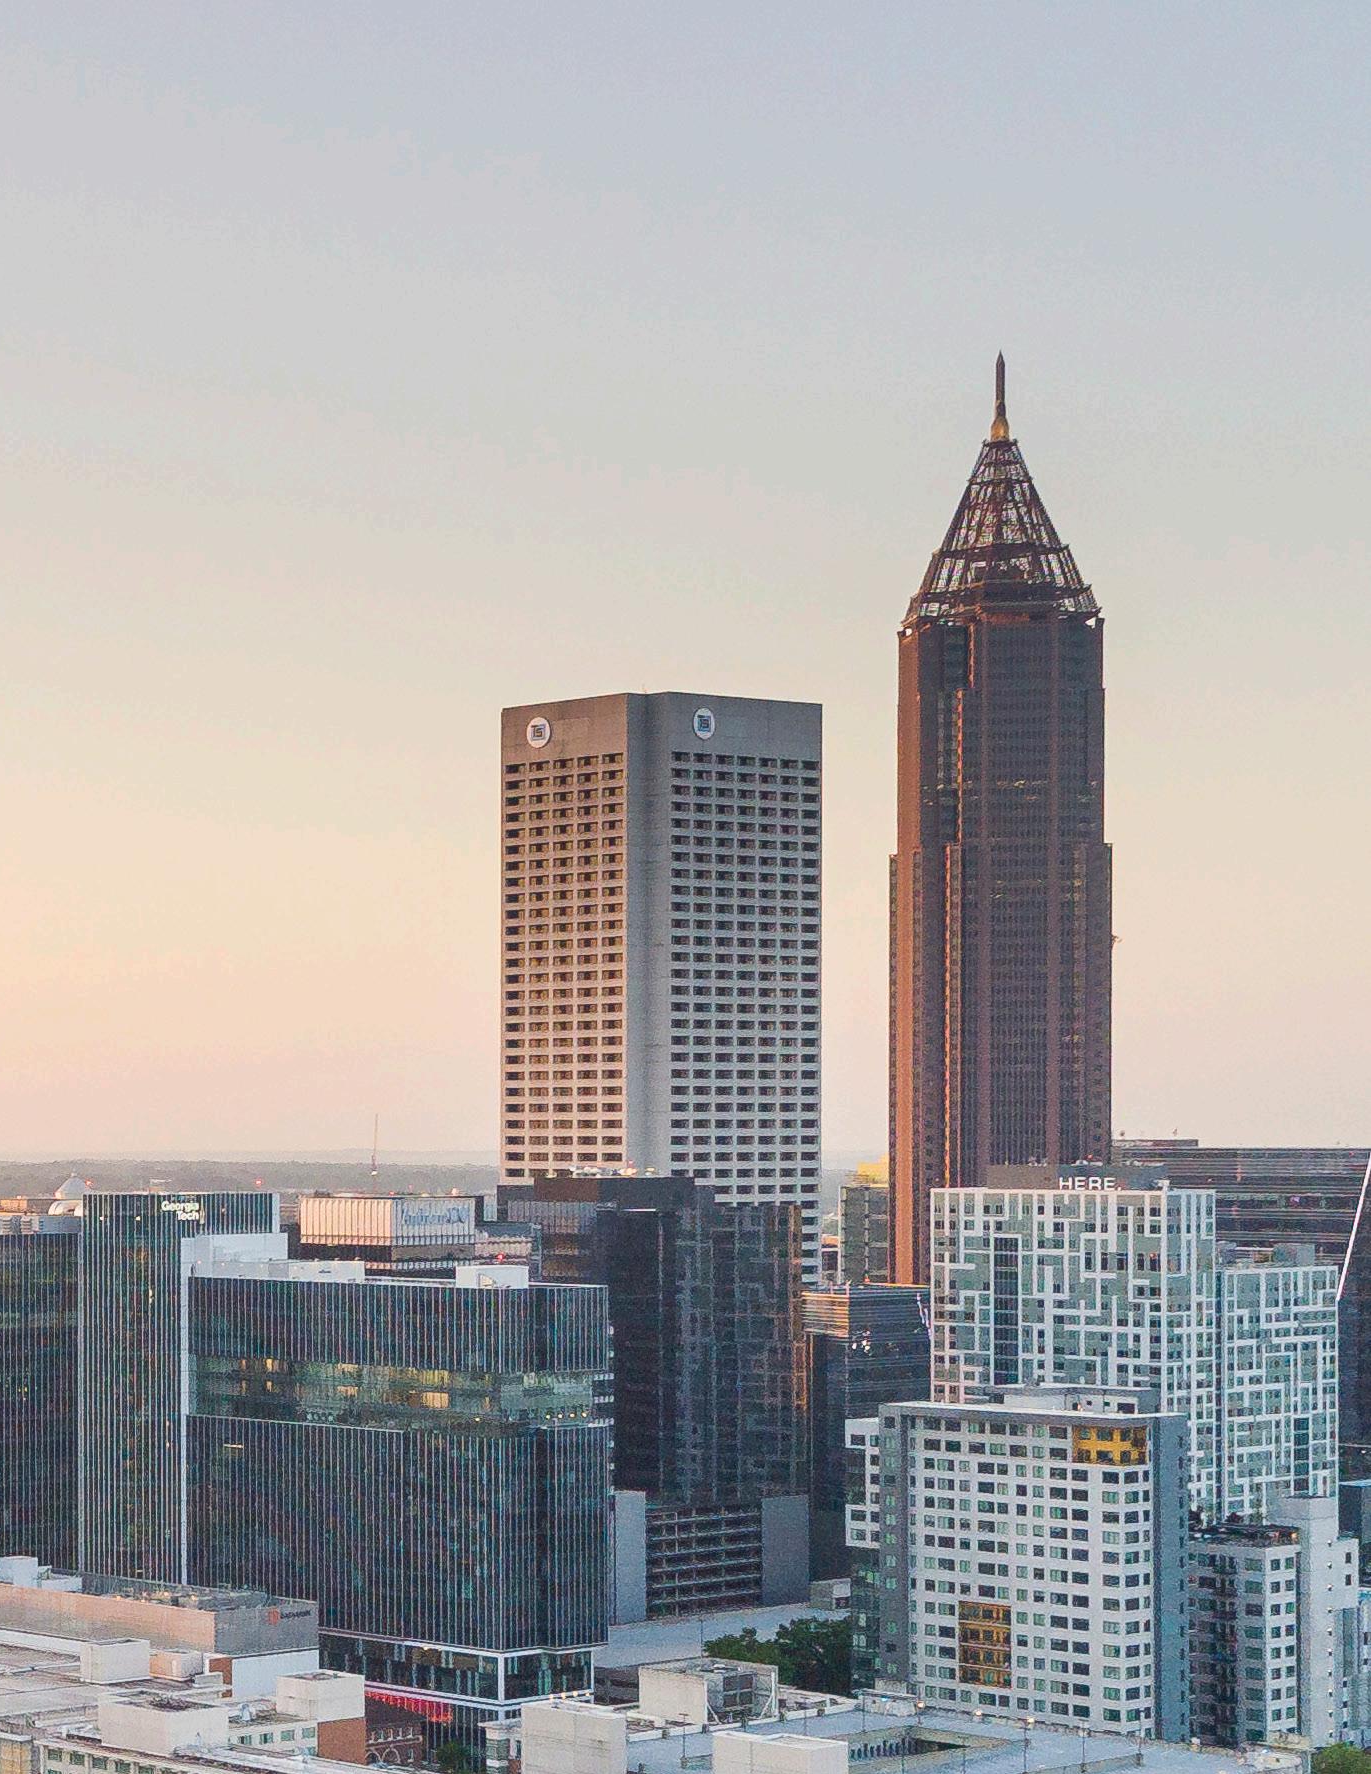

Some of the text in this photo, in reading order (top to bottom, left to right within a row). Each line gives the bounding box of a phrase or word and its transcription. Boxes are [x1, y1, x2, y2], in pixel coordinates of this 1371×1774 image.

[1059, 1176, 1122, 1191] HERE.
[161, 1200, 199, 1212] Georgia
[177, 1210, 199, 1220] Tech
